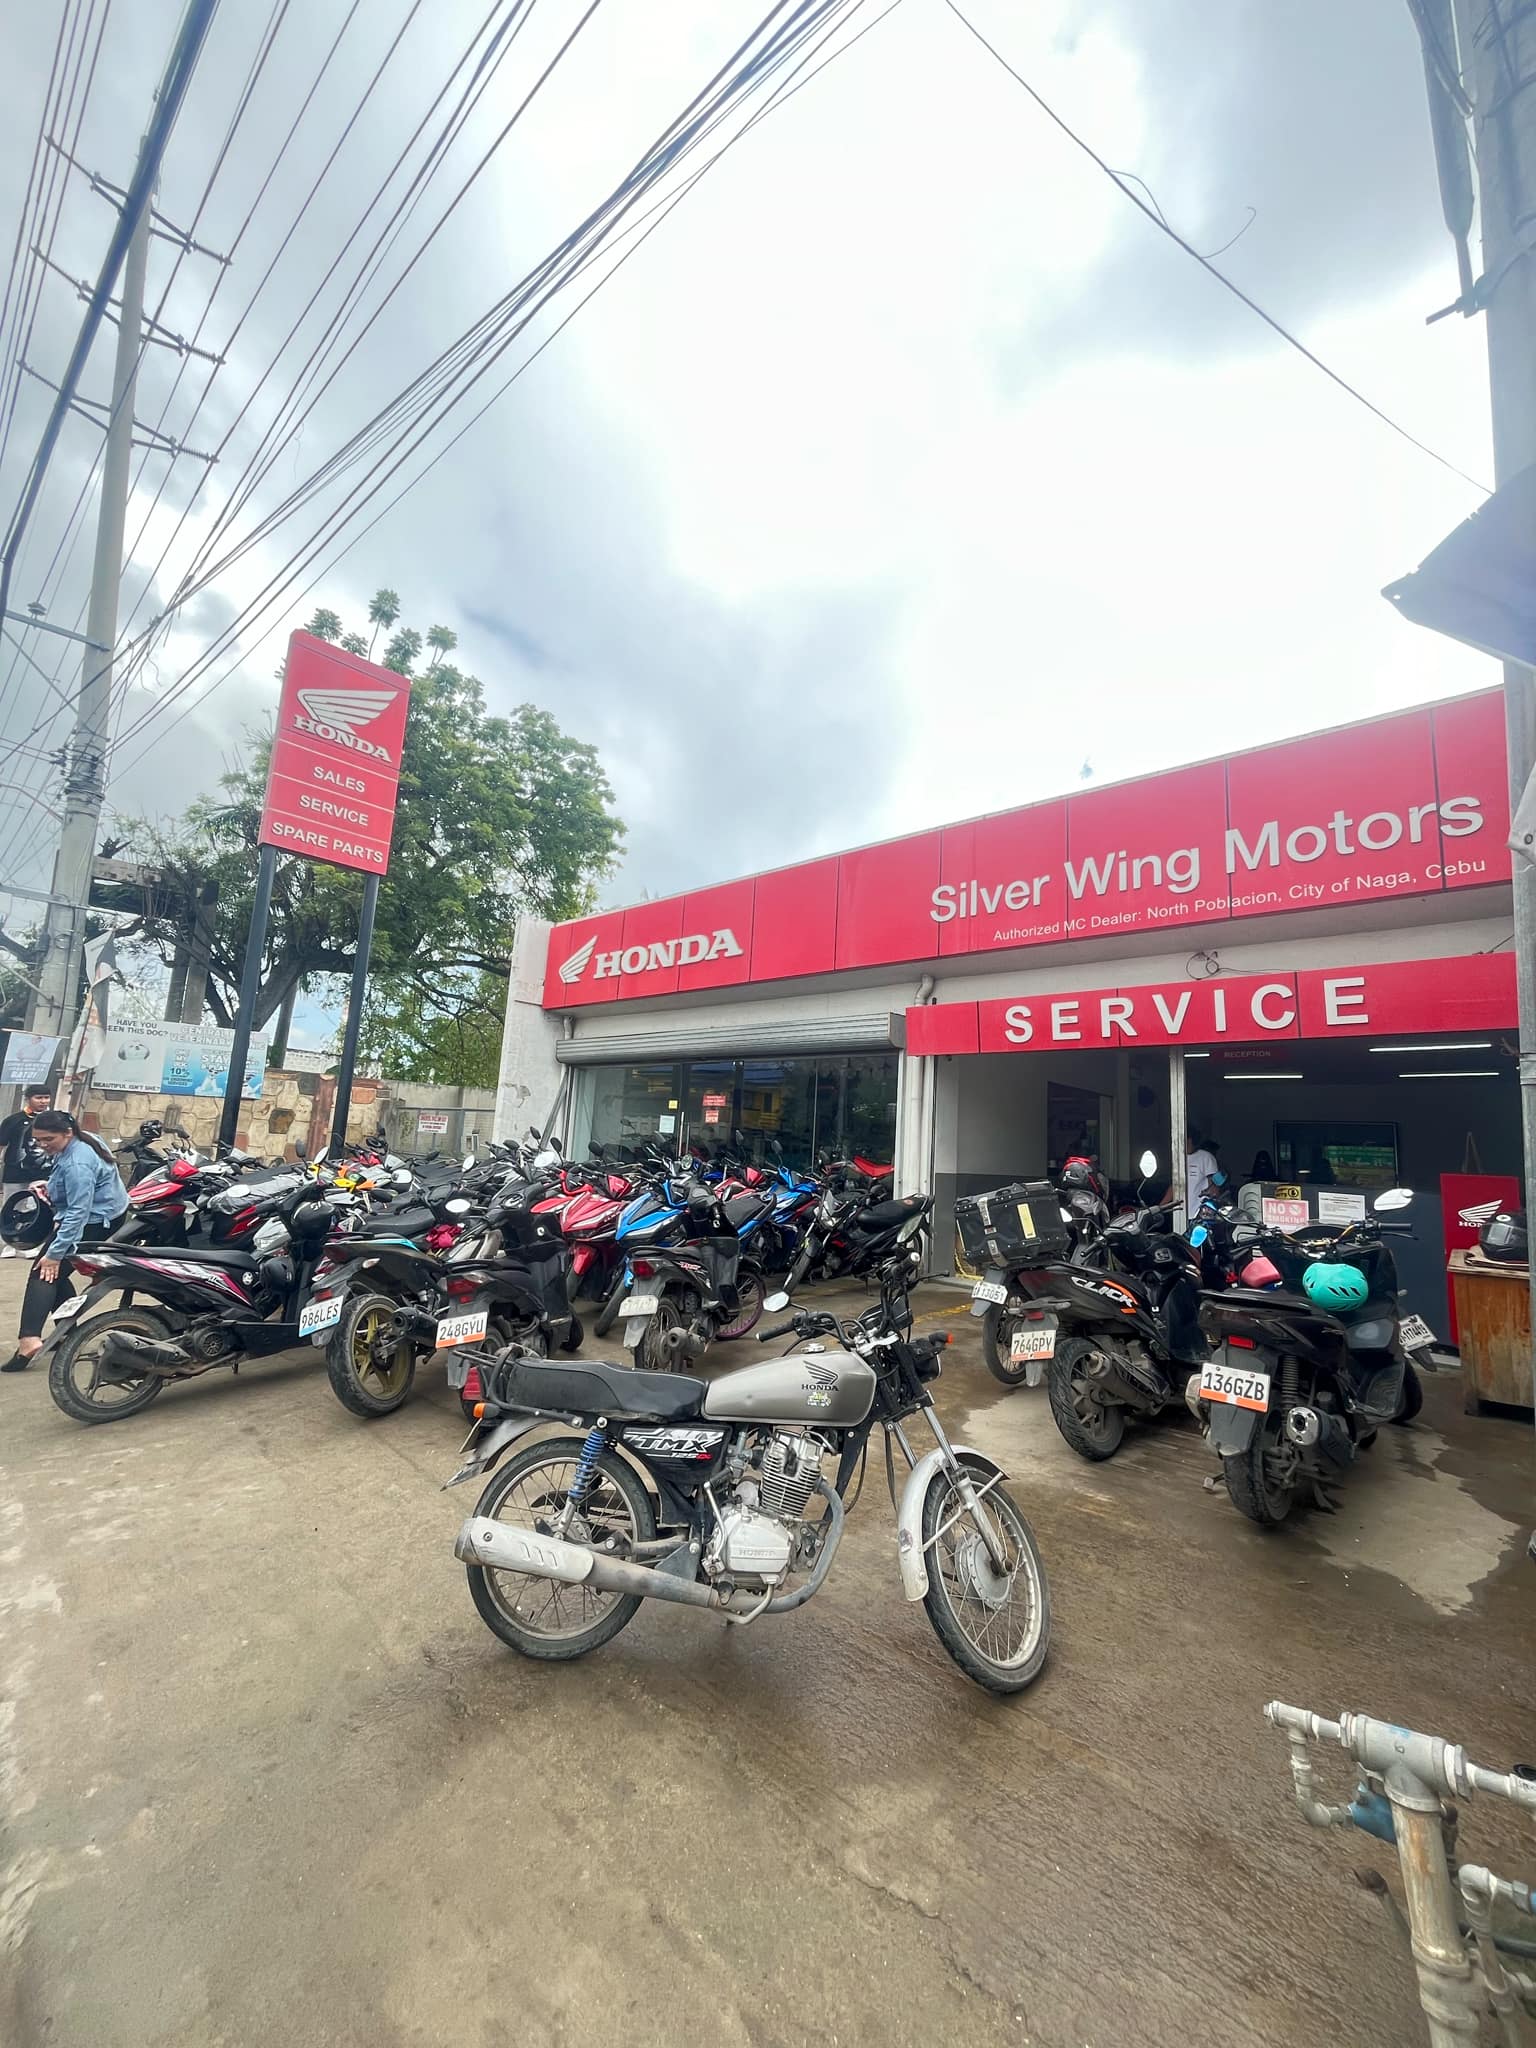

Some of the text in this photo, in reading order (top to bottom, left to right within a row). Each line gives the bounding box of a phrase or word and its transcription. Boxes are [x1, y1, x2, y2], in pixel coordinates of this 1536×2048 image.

[293, 714, 392, 763] HONDA
[313, 766, 366, 793] SALES
[299, 794, 369, 827] SERVICE
[272, 822, 383, 863] SPARE PARTS
[929, 796, 1484, 923] Silver Wing Motors
[993, 859, 1486, 942] Authorized MC Dealer: North Poblacion, City of Naga, Cebu
[593, 928, 744, 979] HONDA
[116, 1019, 157, 1029] HAVE YOU
[1003, 976, 1370, 1045] SERVICE
[128, 1026, 145, 1035] THIS
[1224, 1050, 1271, 1058] RECEPTION
[1268, 1202, 1286, 1214] NO
[1071, 1276, 1133, 1307] CLICK
[302, 1303, 339, 1329] 986LES
[440, 1319, 484, 1340] 248GYU
[1013, 1337, 1052, 1354] 764GPY
[1203, 1371, 1265, 1400] 136GZB
[637, 1438, 710, 1452] TMX
